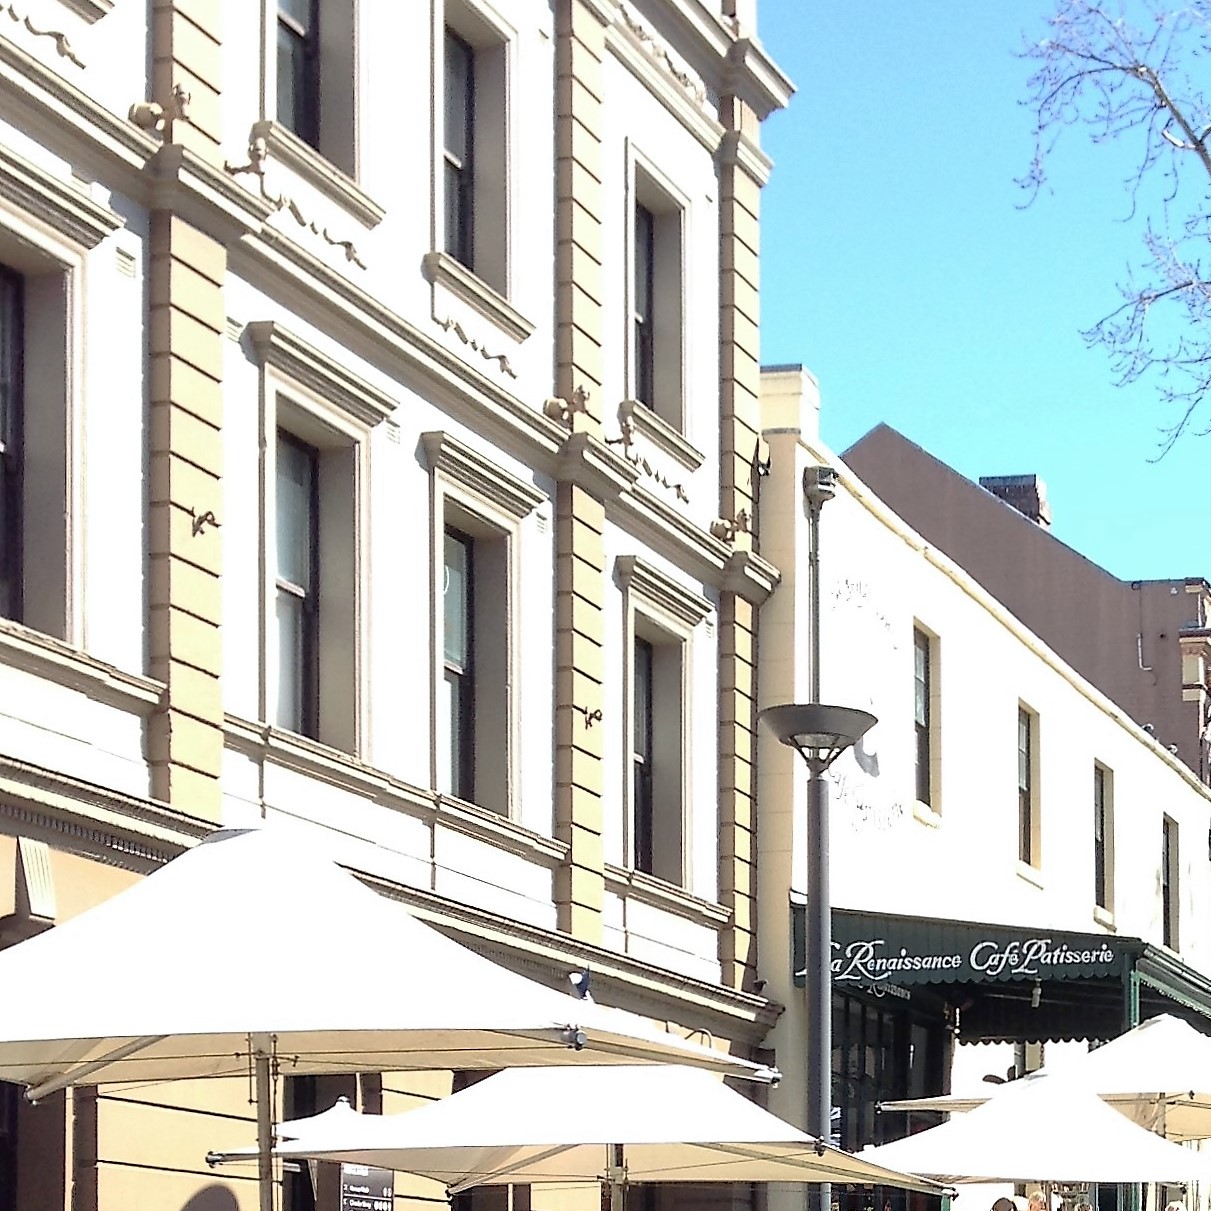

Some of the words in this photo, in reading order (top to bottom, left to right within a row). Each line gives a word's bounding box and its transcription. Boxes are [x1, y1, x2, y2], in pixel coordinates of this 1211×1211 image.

[834, 940, 962, 981] Renaissance
[970, 941, 1019, 976] Café
[1012, 939, 1114, 975] Patisserie
